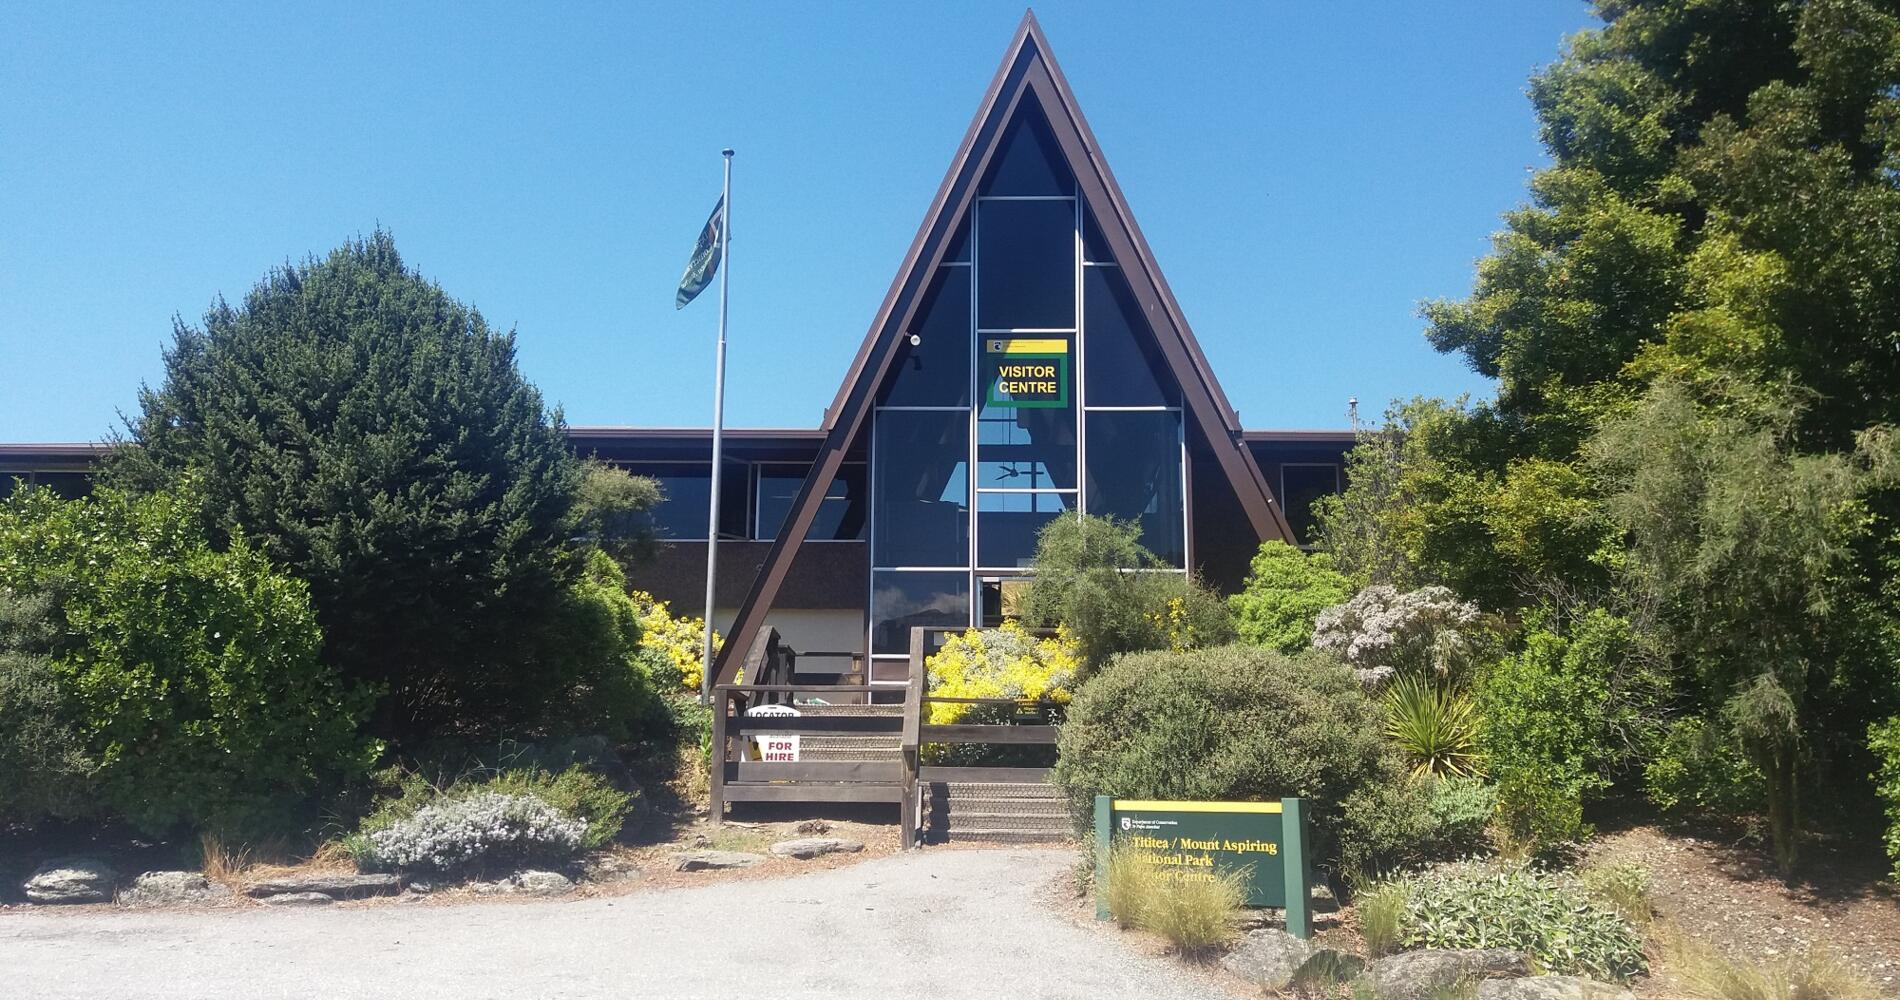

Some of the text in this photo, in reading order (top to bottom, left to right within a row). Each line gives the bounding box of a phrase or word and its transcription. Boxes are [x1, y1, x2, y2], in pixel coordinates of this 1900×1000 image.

[999, 366, 1055, 378] VISITOR
[999, 381, 1057, 394] CENTRE
[768, 741, 793, 751] FOR
[765, 752, 795, 761] HIRE
[1133, 836, 1278, 856] Tititea / Mount Aspiring
[1184, 854, 1214, 866] Park
[1175, 870, 1215, 883] Centre
